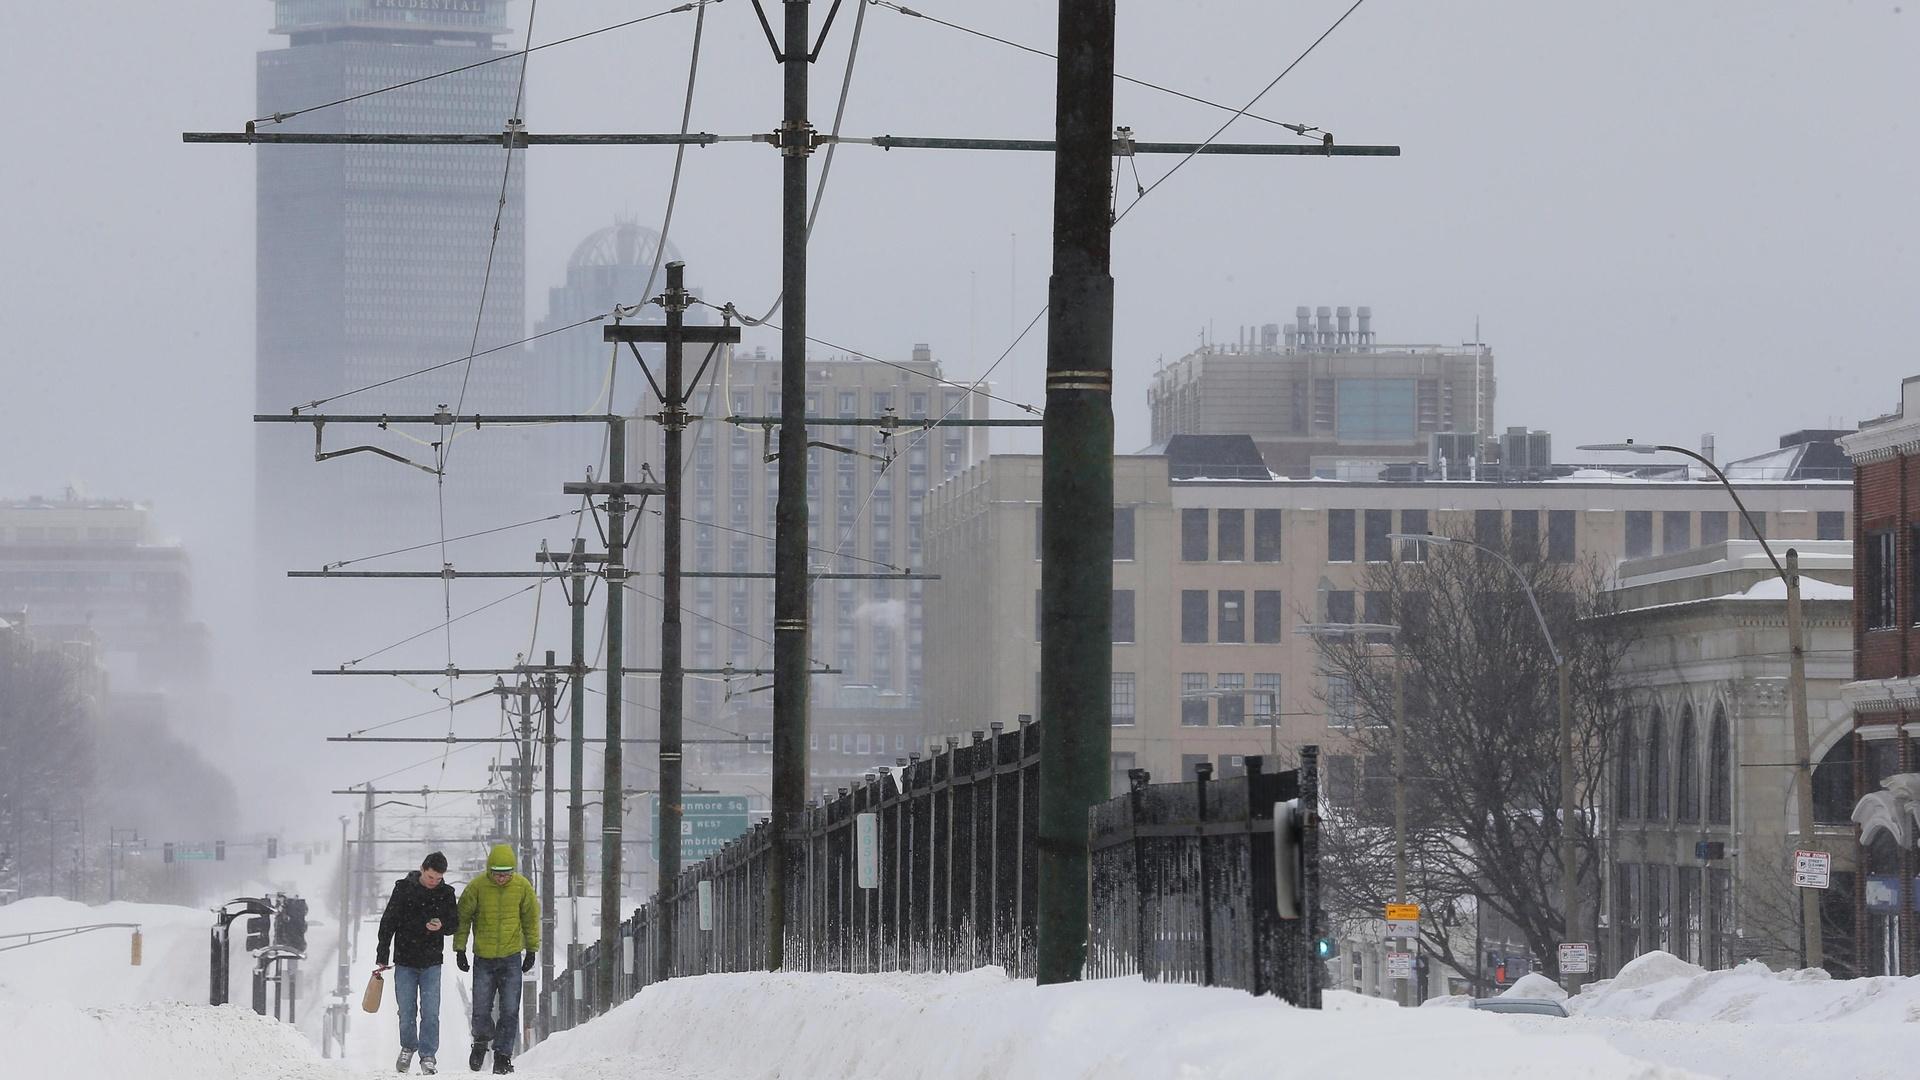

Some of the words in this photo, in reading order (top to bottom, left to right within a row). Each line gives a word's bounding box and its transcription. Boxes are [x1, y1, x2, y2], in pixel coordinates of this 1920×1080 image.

[375, 0, 481, 11] PRUDENTIAL
[681, 802, 722, 810] enmore
[697, 820, 721, 828] WEST
[681, 836, 730, 847] mbridg
